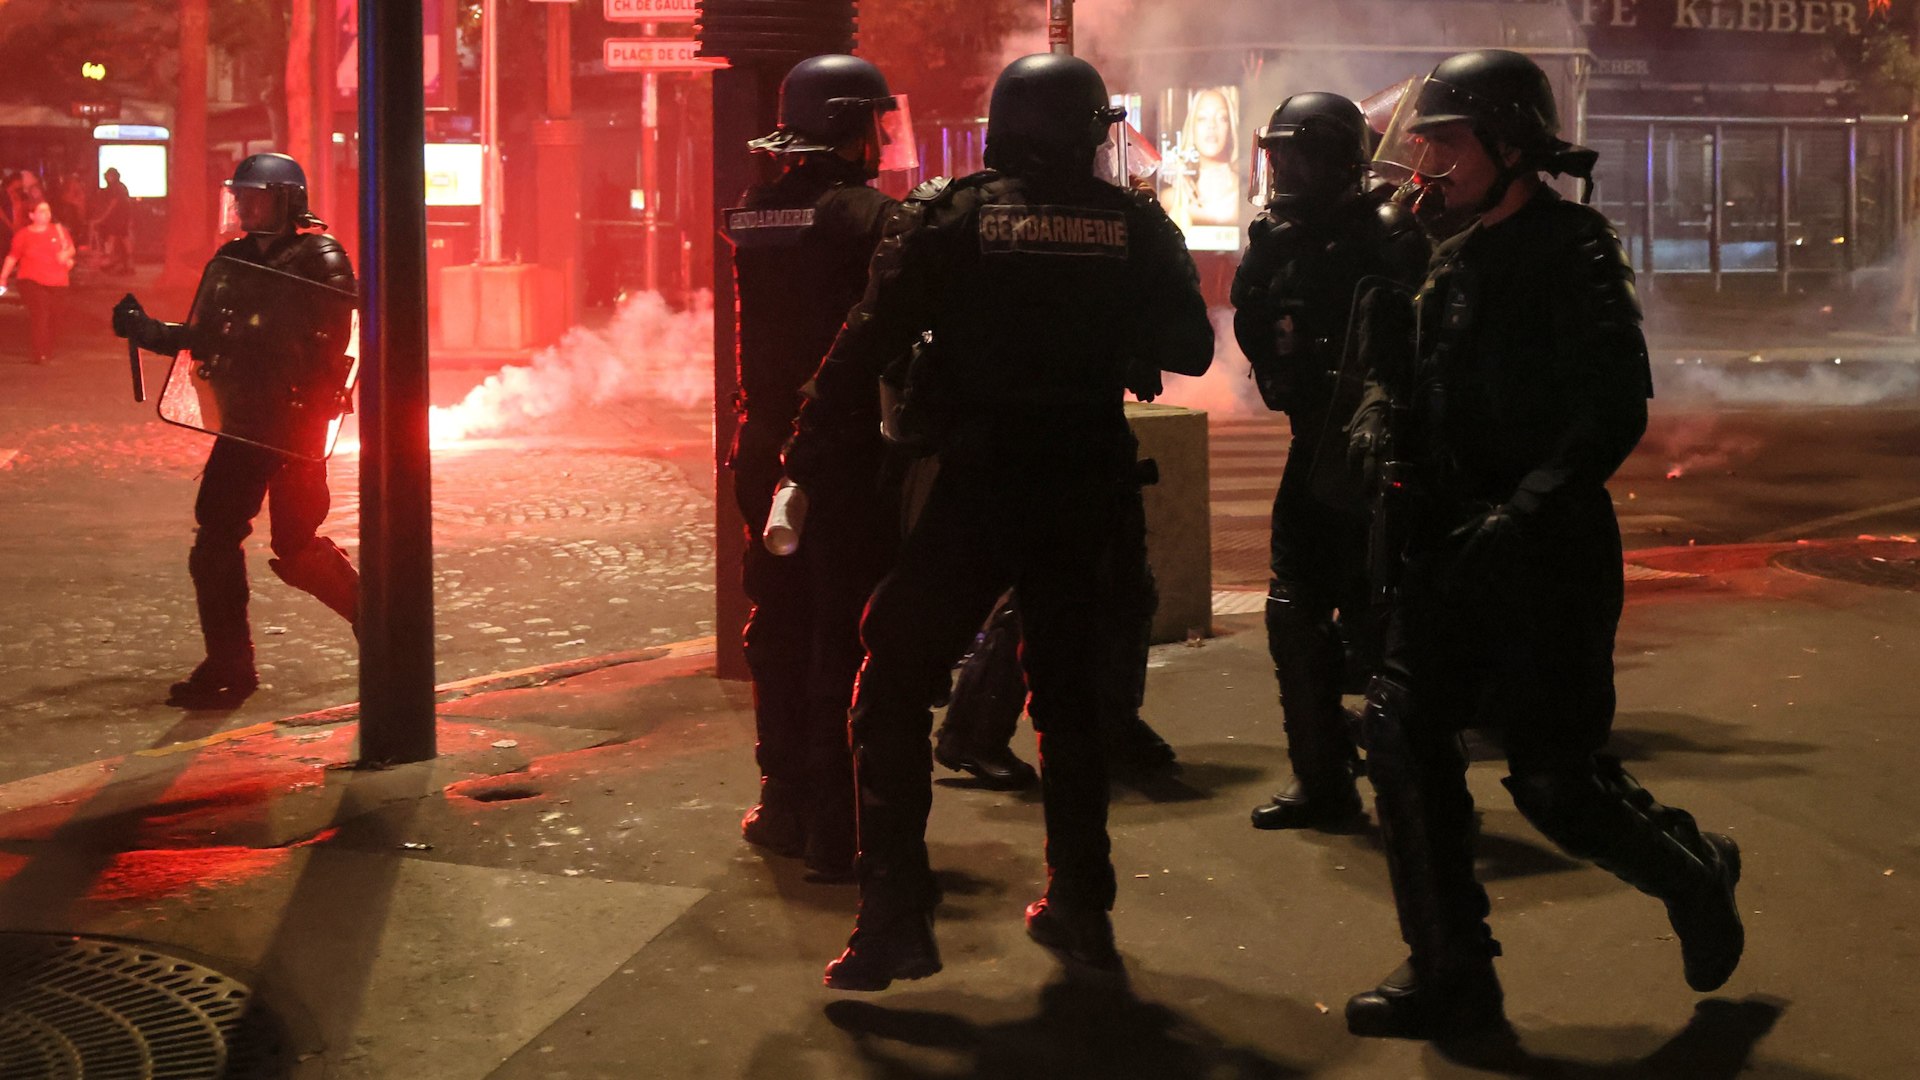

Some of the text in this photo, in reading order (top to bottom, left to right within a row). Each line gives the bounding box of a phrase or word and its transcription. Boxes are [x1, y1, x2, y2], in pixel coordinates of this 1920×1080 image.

[636, 0, 651, 10] DE
[655, 0, 696, 10] GAULL
[1580, 0, 1861, 34] FE KLEBER
[613, 49, 694, 60] PLACE DE CL
[730, 209, 815, 229] GENDARMERIE
[982, 214, 1127, 247] GENDARMERIE
